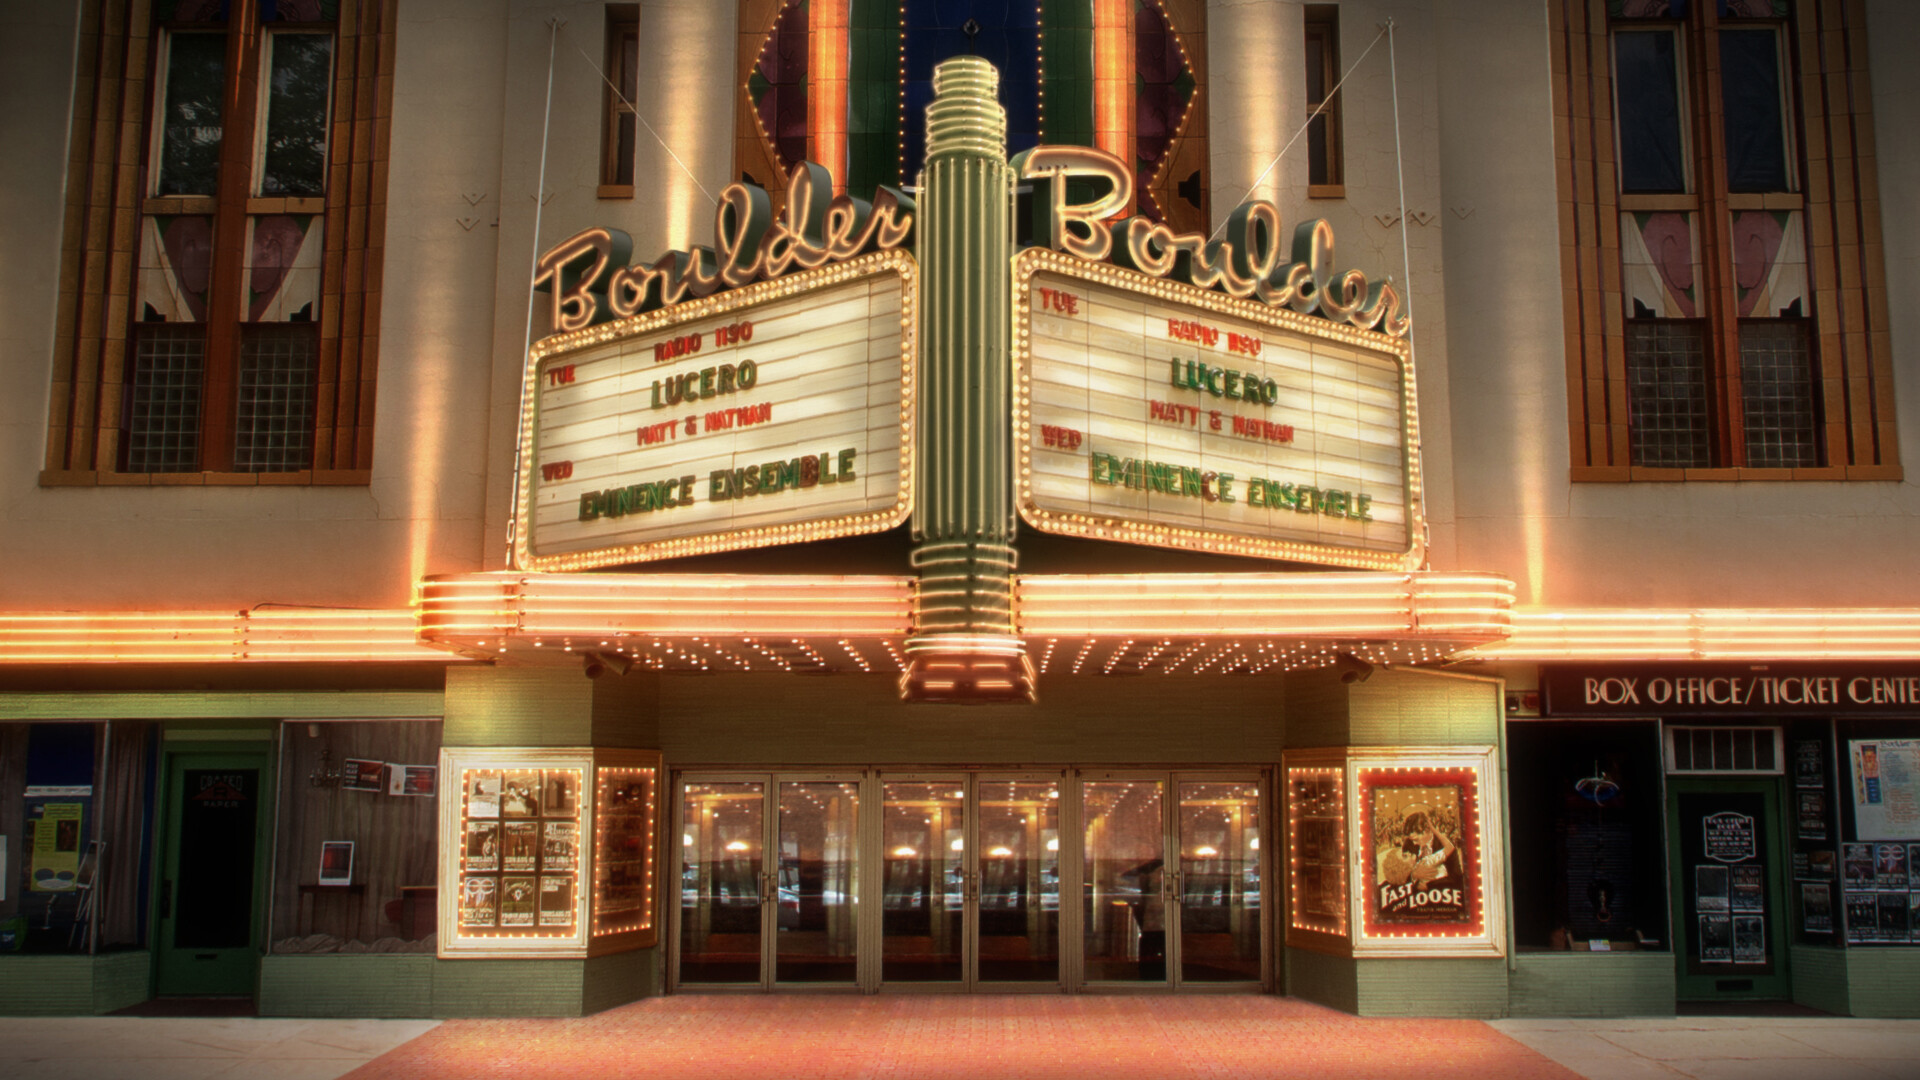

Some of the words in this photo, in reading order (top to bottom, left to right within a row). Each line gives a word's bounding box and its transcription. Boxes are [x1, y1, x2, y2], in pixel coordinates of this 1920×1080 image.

[534, 160, 915, 332] Boulder
[1013, 145, 1411, 337] Boulder
[1039, 286, 1079, 317] TUE
[654, 332, 701, 364] RADIO
[714, 321, 754, 347] 1190
[1168, 318, 1219, 347] RADIO
[548, 364, 576, 387] TUE
[651, 359, 758, 410] LUCERO
[1171, 356, 1279, 407] LUCERO
[637, 419, 678, 446] MATT
[704, 402, 772, 432] NATHAN
[1041, 423, 1082, 450] WED
[1150, 399, 1199, 427] MATT
[1233, 414, 1294, 444] NATHAN
[542, 459, 573, 482] WED
[578, 474, 696, 521] EMINENCE
[709, 448, 857, 502] ENSEMBLE
[1091, 451, 1237, 503] EMINENCE
[1248, 476, 1373, 522] ENSEMBLE
[1584, 677, 1640, 705] BOX
[1381, 883, 1412, 909] FAST
[1409, 888, 1461, 908] LOOSE
